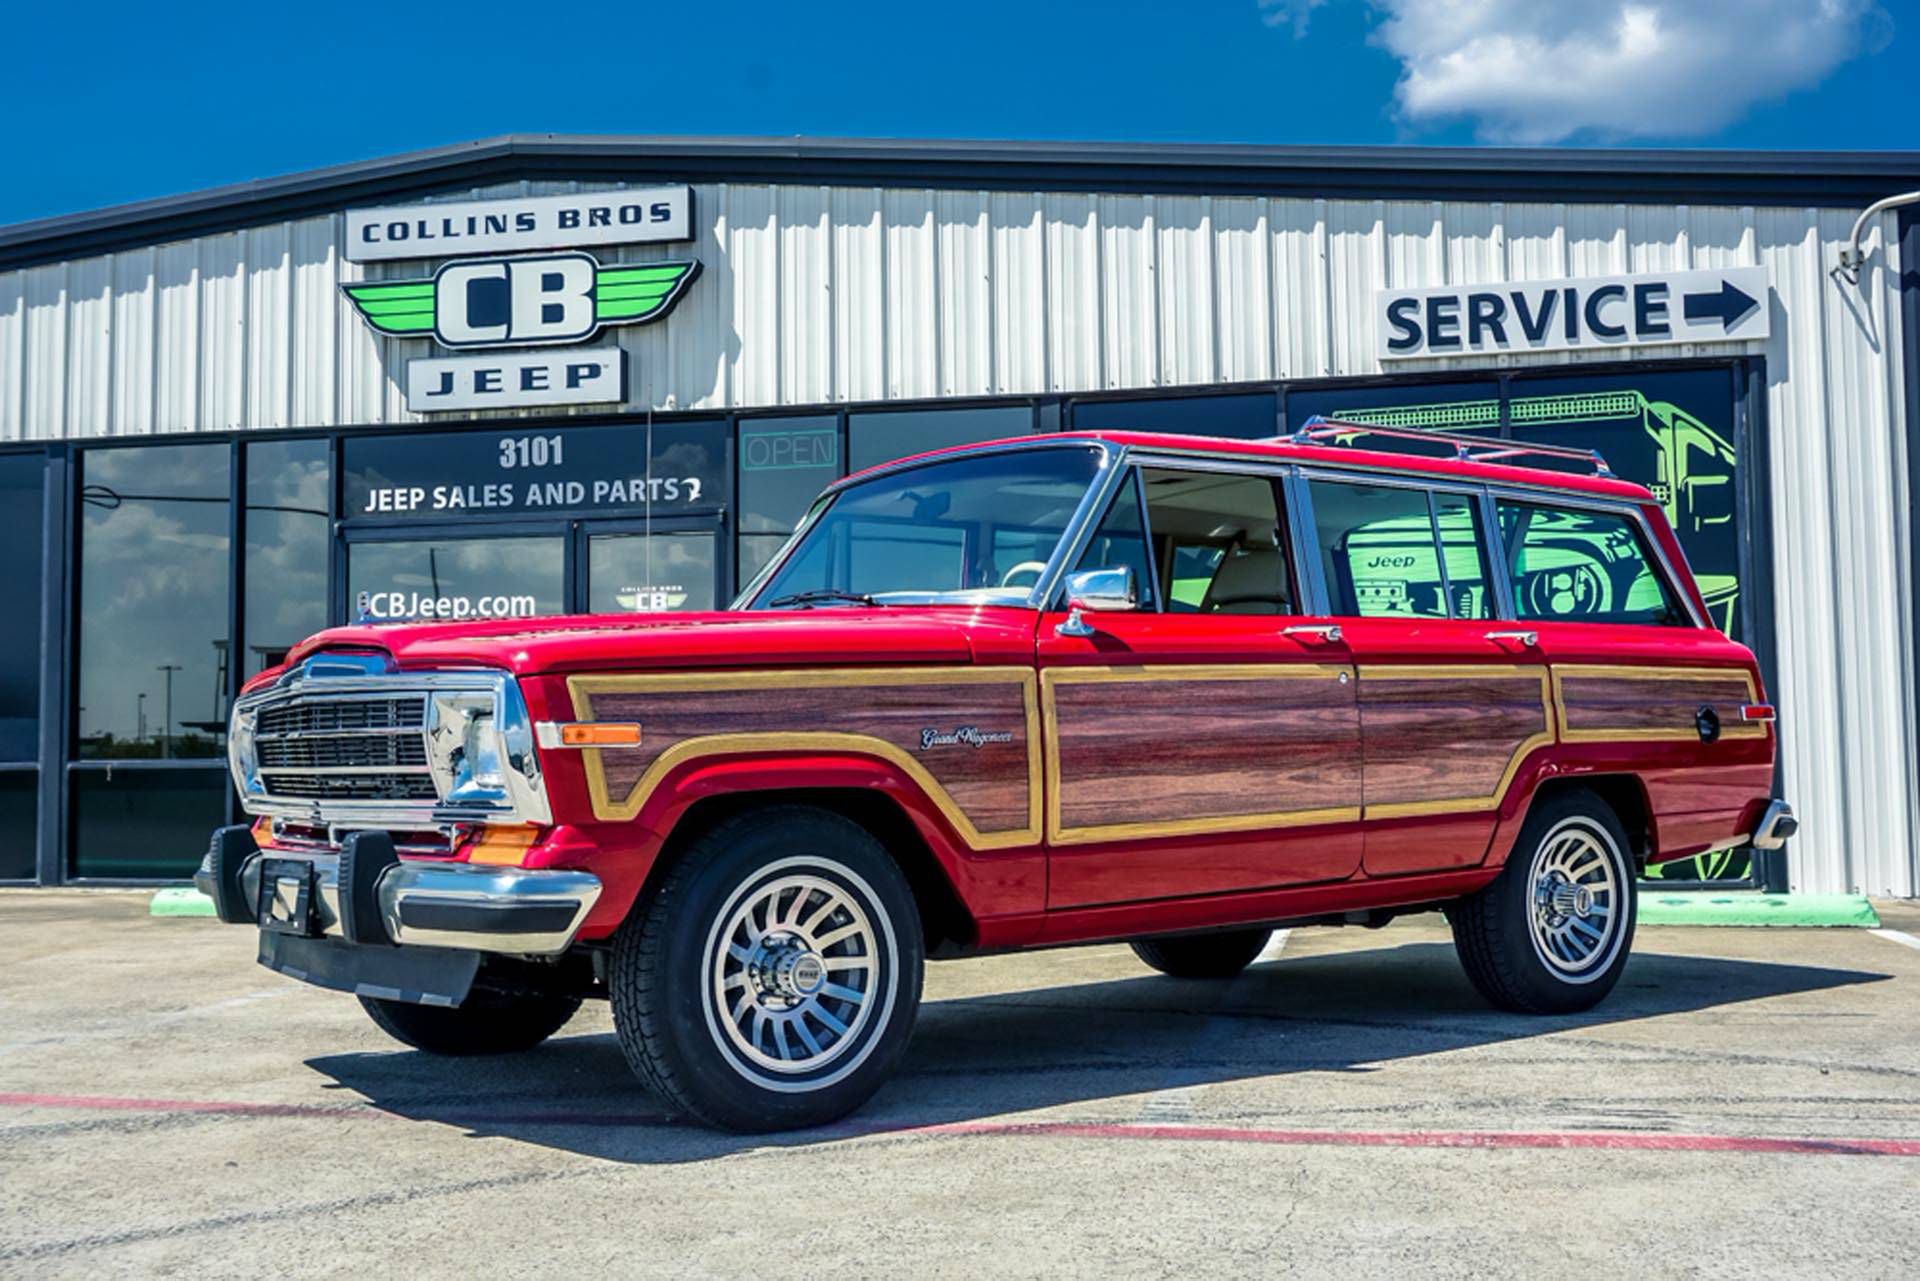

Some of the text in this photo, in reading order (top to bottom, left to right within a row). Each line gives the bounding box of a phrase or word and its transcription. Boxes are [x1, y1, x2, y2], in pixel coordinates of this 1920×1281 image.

[362, 202, 671, 243] COLLINS BROS
[437, 258, 594, 343] CB
[1386, 281, 1671, 351] SERVICE
[426, 362, 602, 396] JEEP
[499, 435, 563, 468] 3101
[747, 435, 833, 465] OPEN
[364, 477, 679, 512] JEEP SALES AND PARTS
[1367, 556, 1416, 568] Jeep
[371, 592, 535, 618] CBJeep.com
